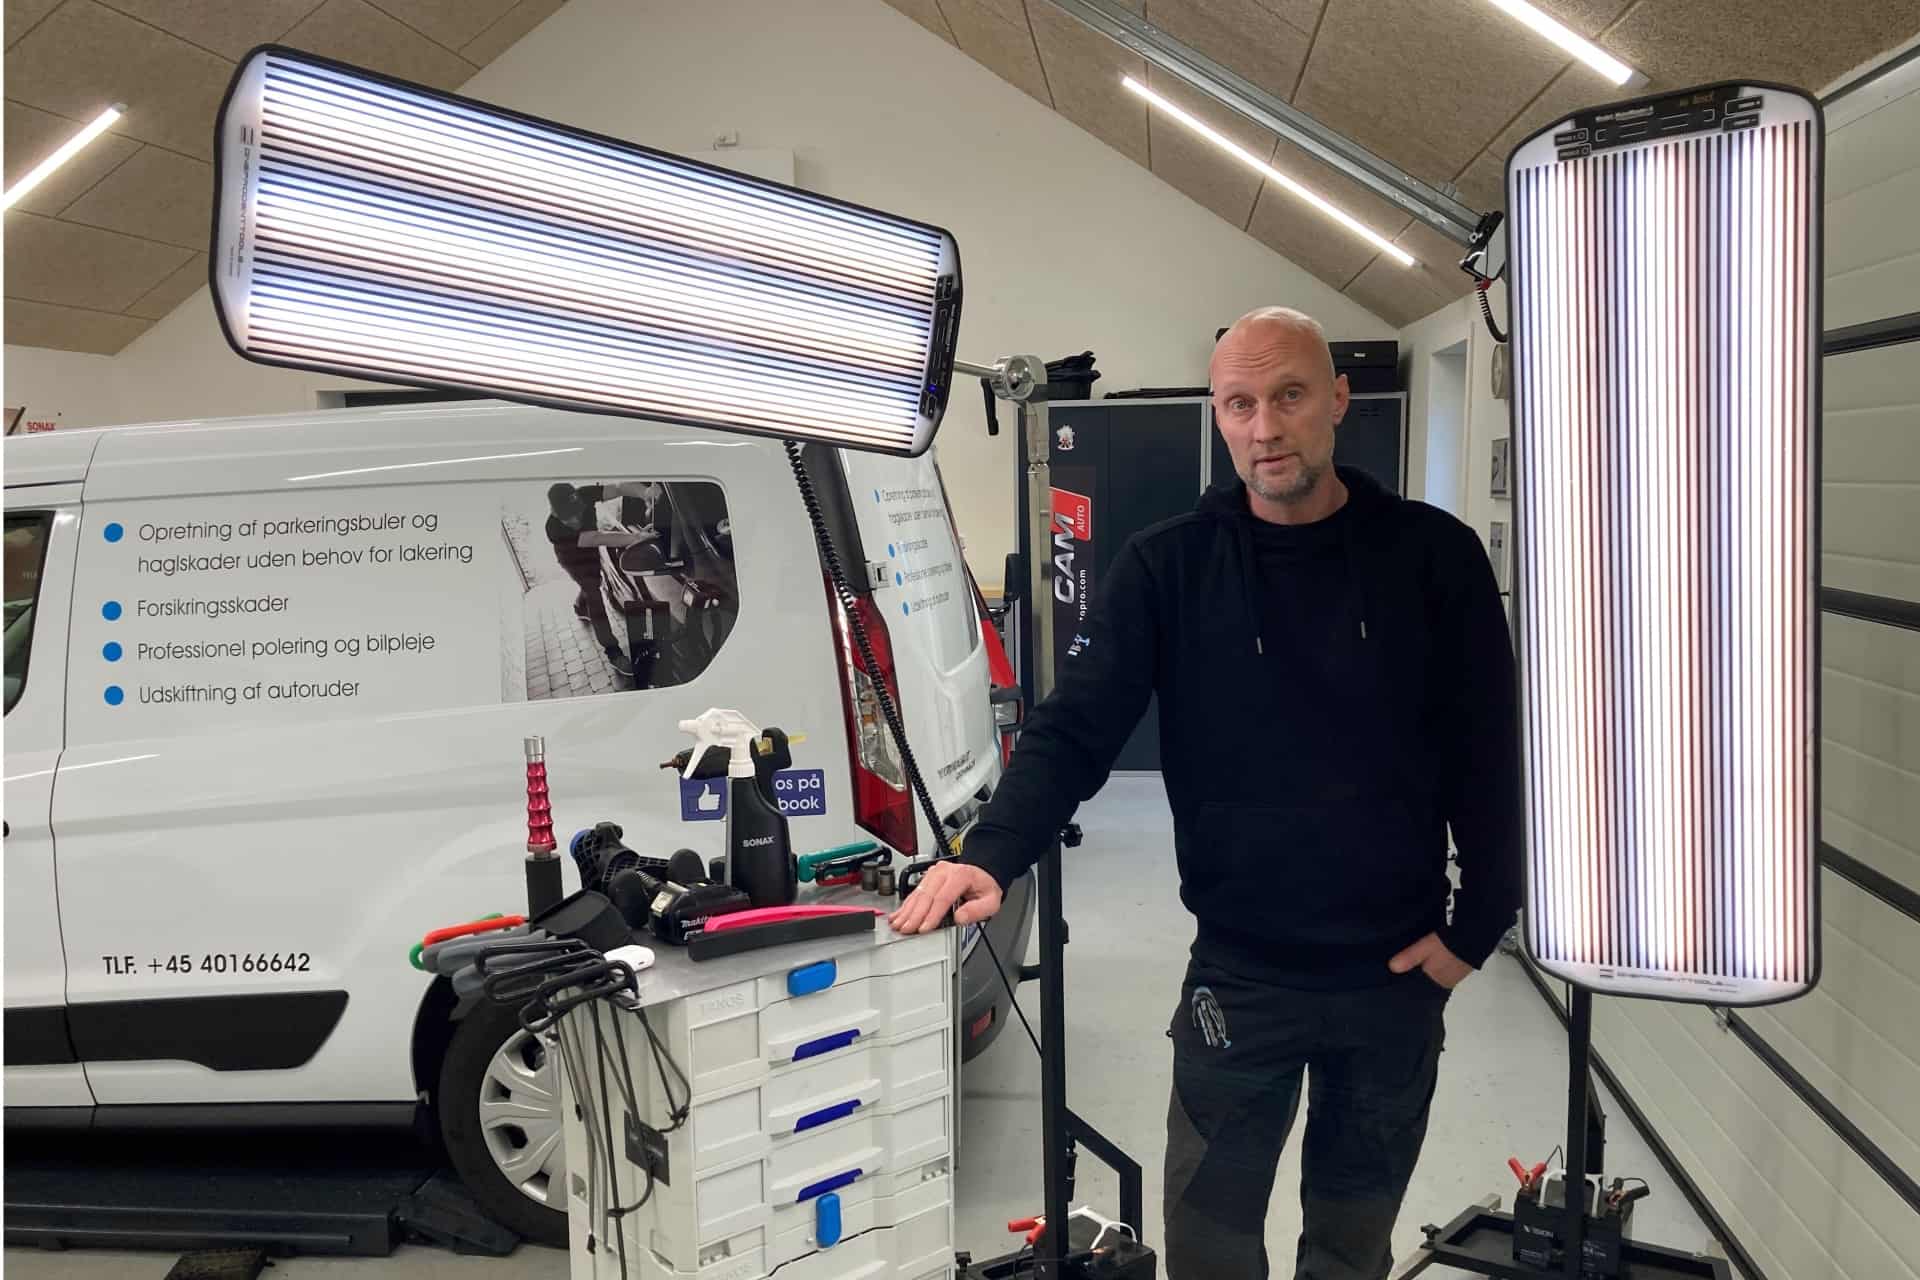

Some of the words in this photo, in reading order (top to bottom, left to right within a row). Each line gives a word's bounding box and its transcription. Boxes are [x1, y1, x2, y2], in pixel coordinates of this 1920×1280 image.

[139, 522, 232, 544] Opretning
[239, 520, 258, 536] af
[264, 513, 406, 539] parkeringsbuler
[412, 514, 437, 532] og
[1077, 504, 1086, 532] AUTO
[138, 553, 240, 576] haglskader
[247, 551, 295, 568] uden
[303, 548, 363, 566] behov
[369, 546, 393, 563] for
[400, 543, 472, 563] lakering
[1054, 512, 1075, 603] CAM
[138, 595, 288, 618] Forsikringsskader
[138, 640, 245, 660] Professionel
[252, 637, 328, 660] polering
[334, 639, 359, 656] og
[367, 633, 435, 655] bilpleje
[140, 684, 236, 704] Udskiftning
[243, 682, 262, 700] af
[268, 680, 360, 699] autoruder
[775, 779, 793, 790] os
[798, 773, 820, 791] på
[743, 836, 775, 847] SONAX
[102, 956, 136, 975] TLF.
[148, 955, 192, 973] +45
[200, 953, 310, 973] 40166642
